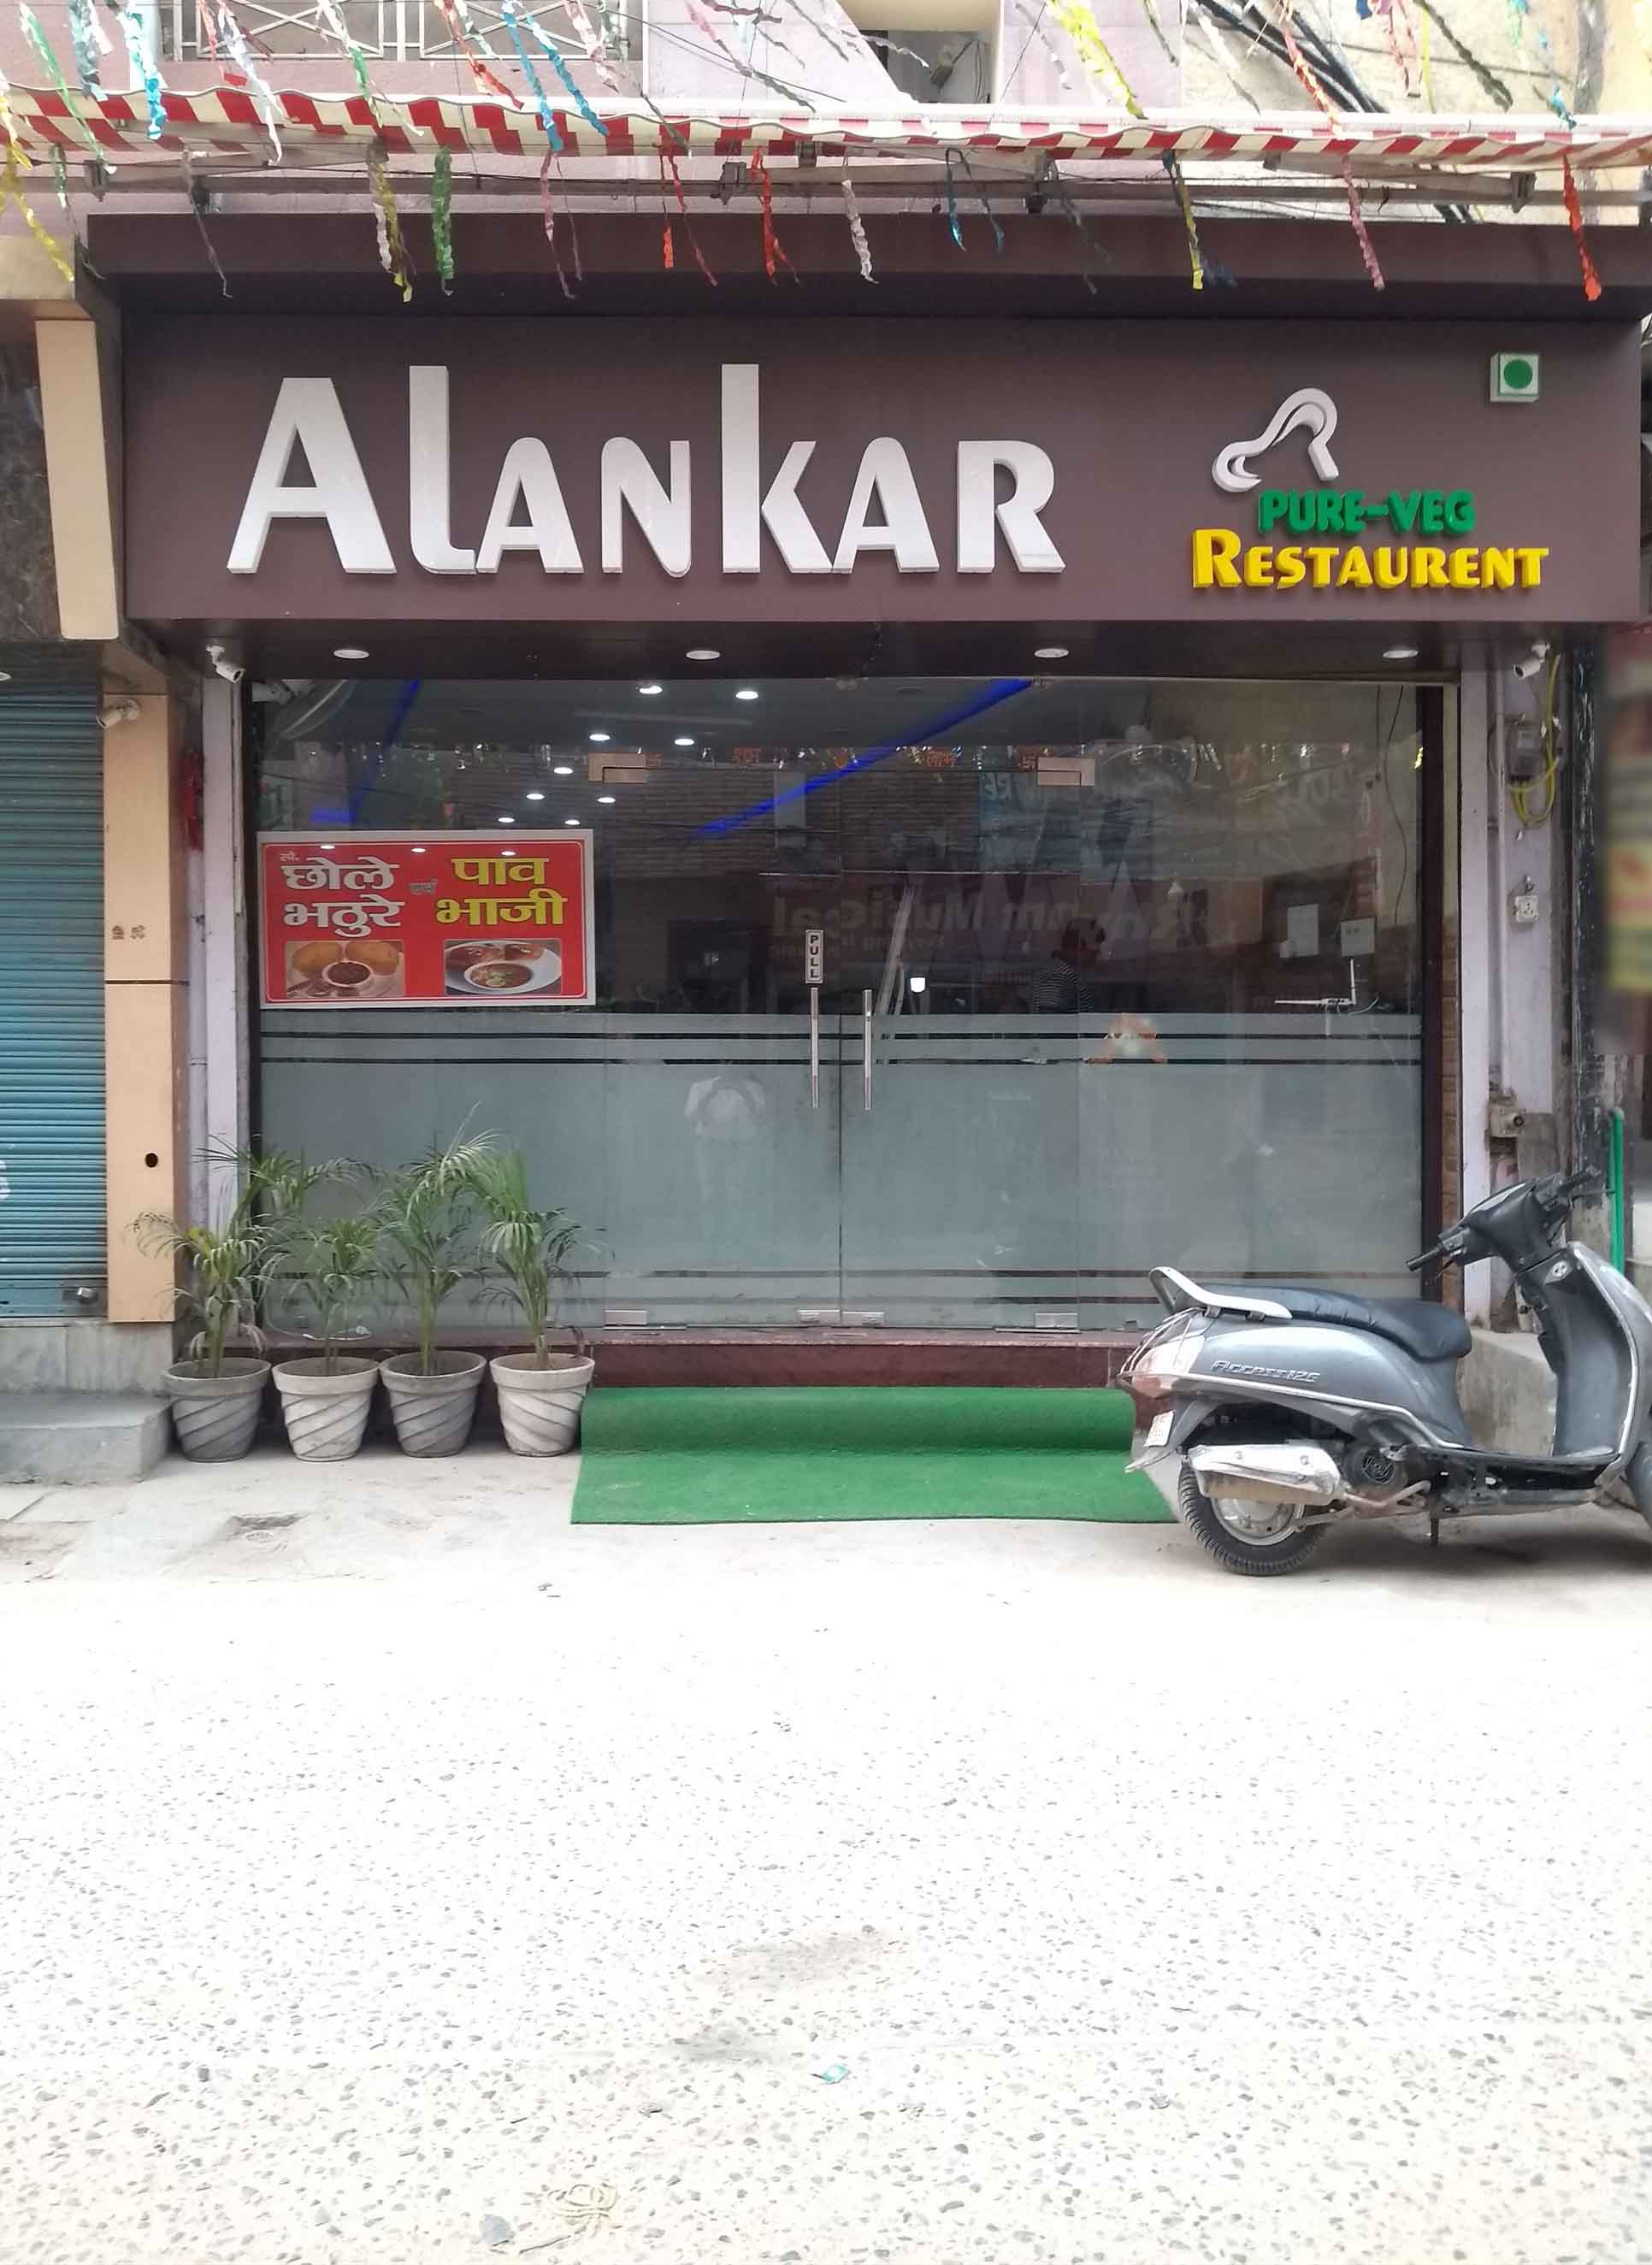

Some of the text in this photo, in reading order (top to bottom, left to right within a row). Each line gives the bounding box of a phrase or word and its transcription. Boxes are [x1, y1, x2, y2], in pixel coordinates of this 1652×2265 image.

[1258, 490, 1476, 534] PURE-VEG
[1192, 528, 1549, 589] RESTAURENT
[280, 856, 400, 891] छोले
[451, 857, 550, 887] पाव
[434, 888, 568, 926] भाजी
[809, 934, 820, 979] PULL
